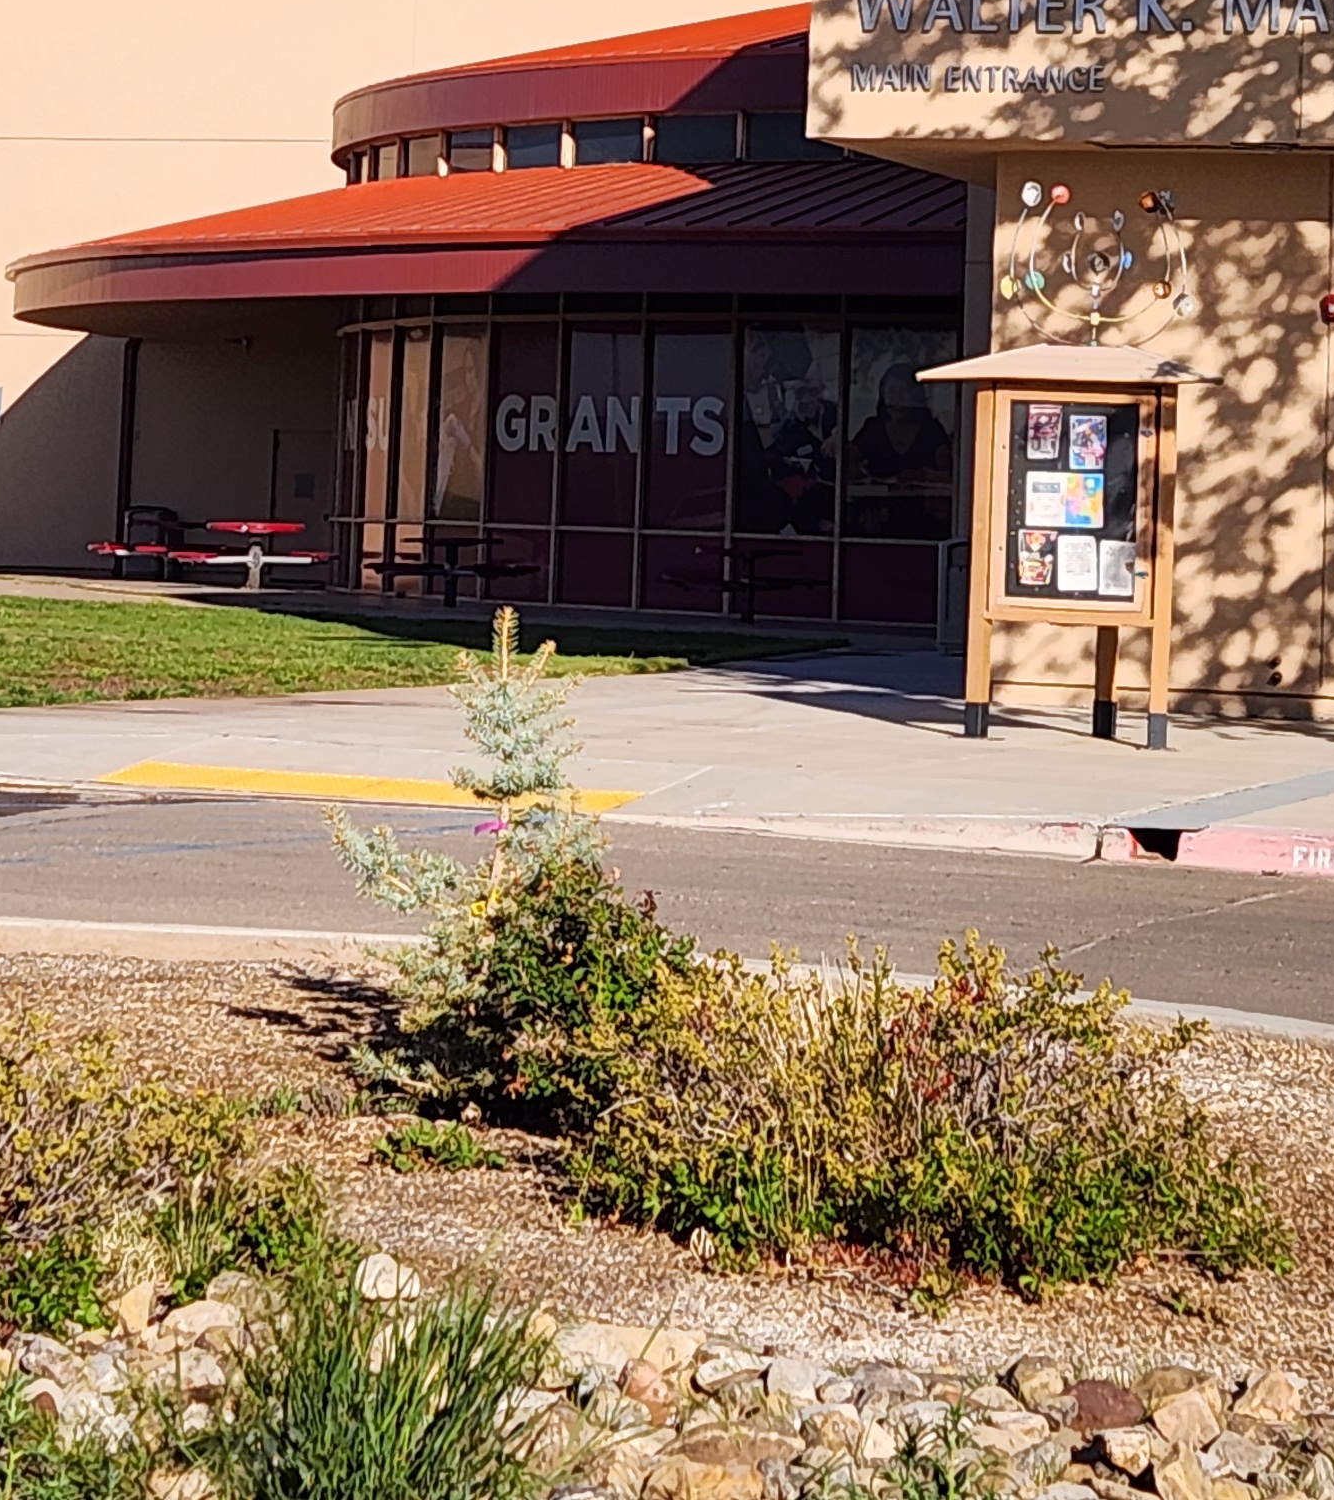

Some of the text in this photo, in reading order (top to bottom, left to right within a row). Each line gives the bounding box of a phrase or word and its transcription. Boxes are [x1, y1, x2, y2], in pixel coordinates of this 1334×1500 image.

[851, 63, 1105, 94] MAIN ENTRANCE
[495, 394, 726, 457] GRANTS
